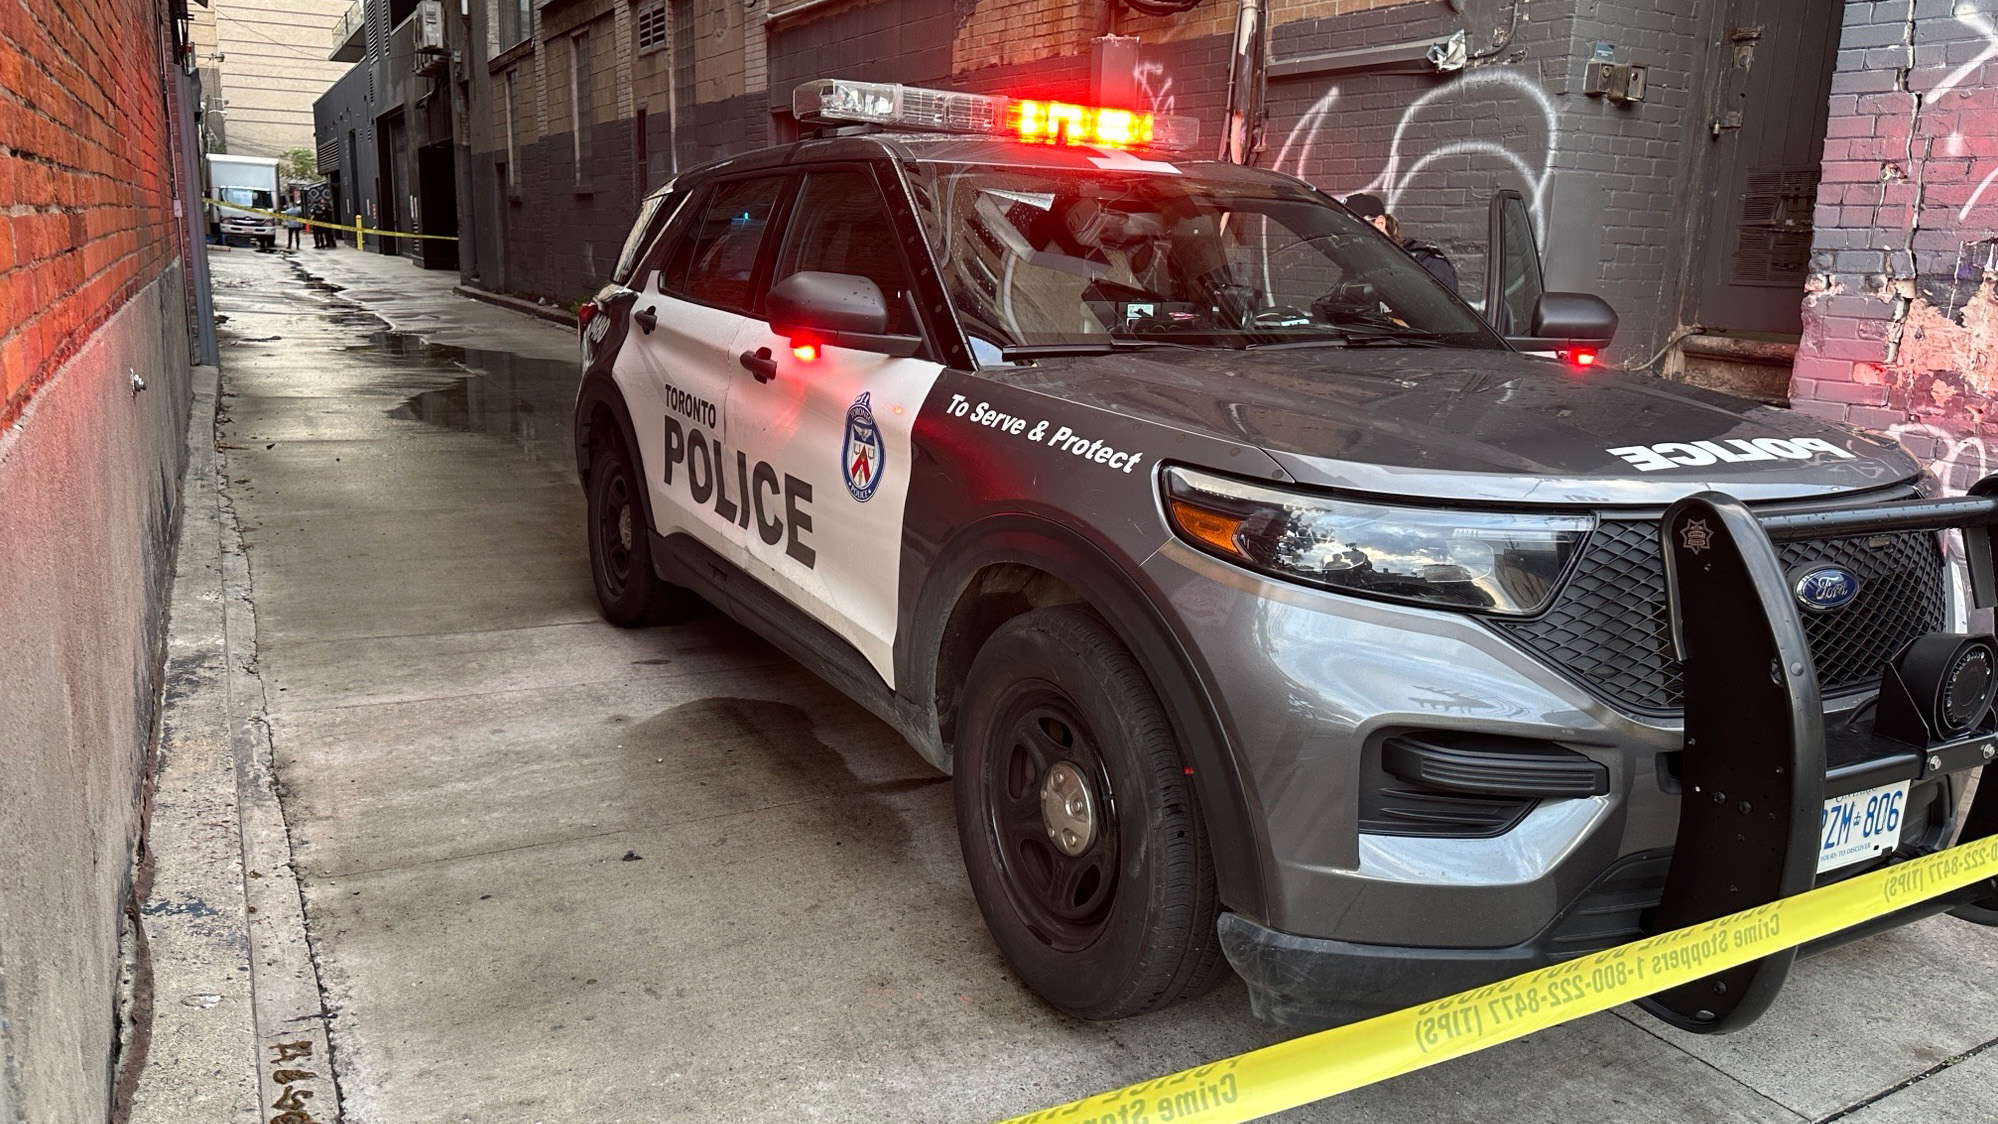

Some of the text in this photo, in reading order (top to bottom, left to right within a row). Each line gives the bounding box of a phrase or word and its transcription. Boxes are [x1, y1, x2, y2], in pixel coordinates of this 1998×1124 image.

[665, 384, 716, 429] TORONTO
[946, 394, 1143, 474] To Serve & Protect
[663, 415, 817, 570] POLICE
[849, 485, 869, 499] POLICE
[1815, 576, 1848, 600] Ford
[1863, 790, 1902, 838] 806
